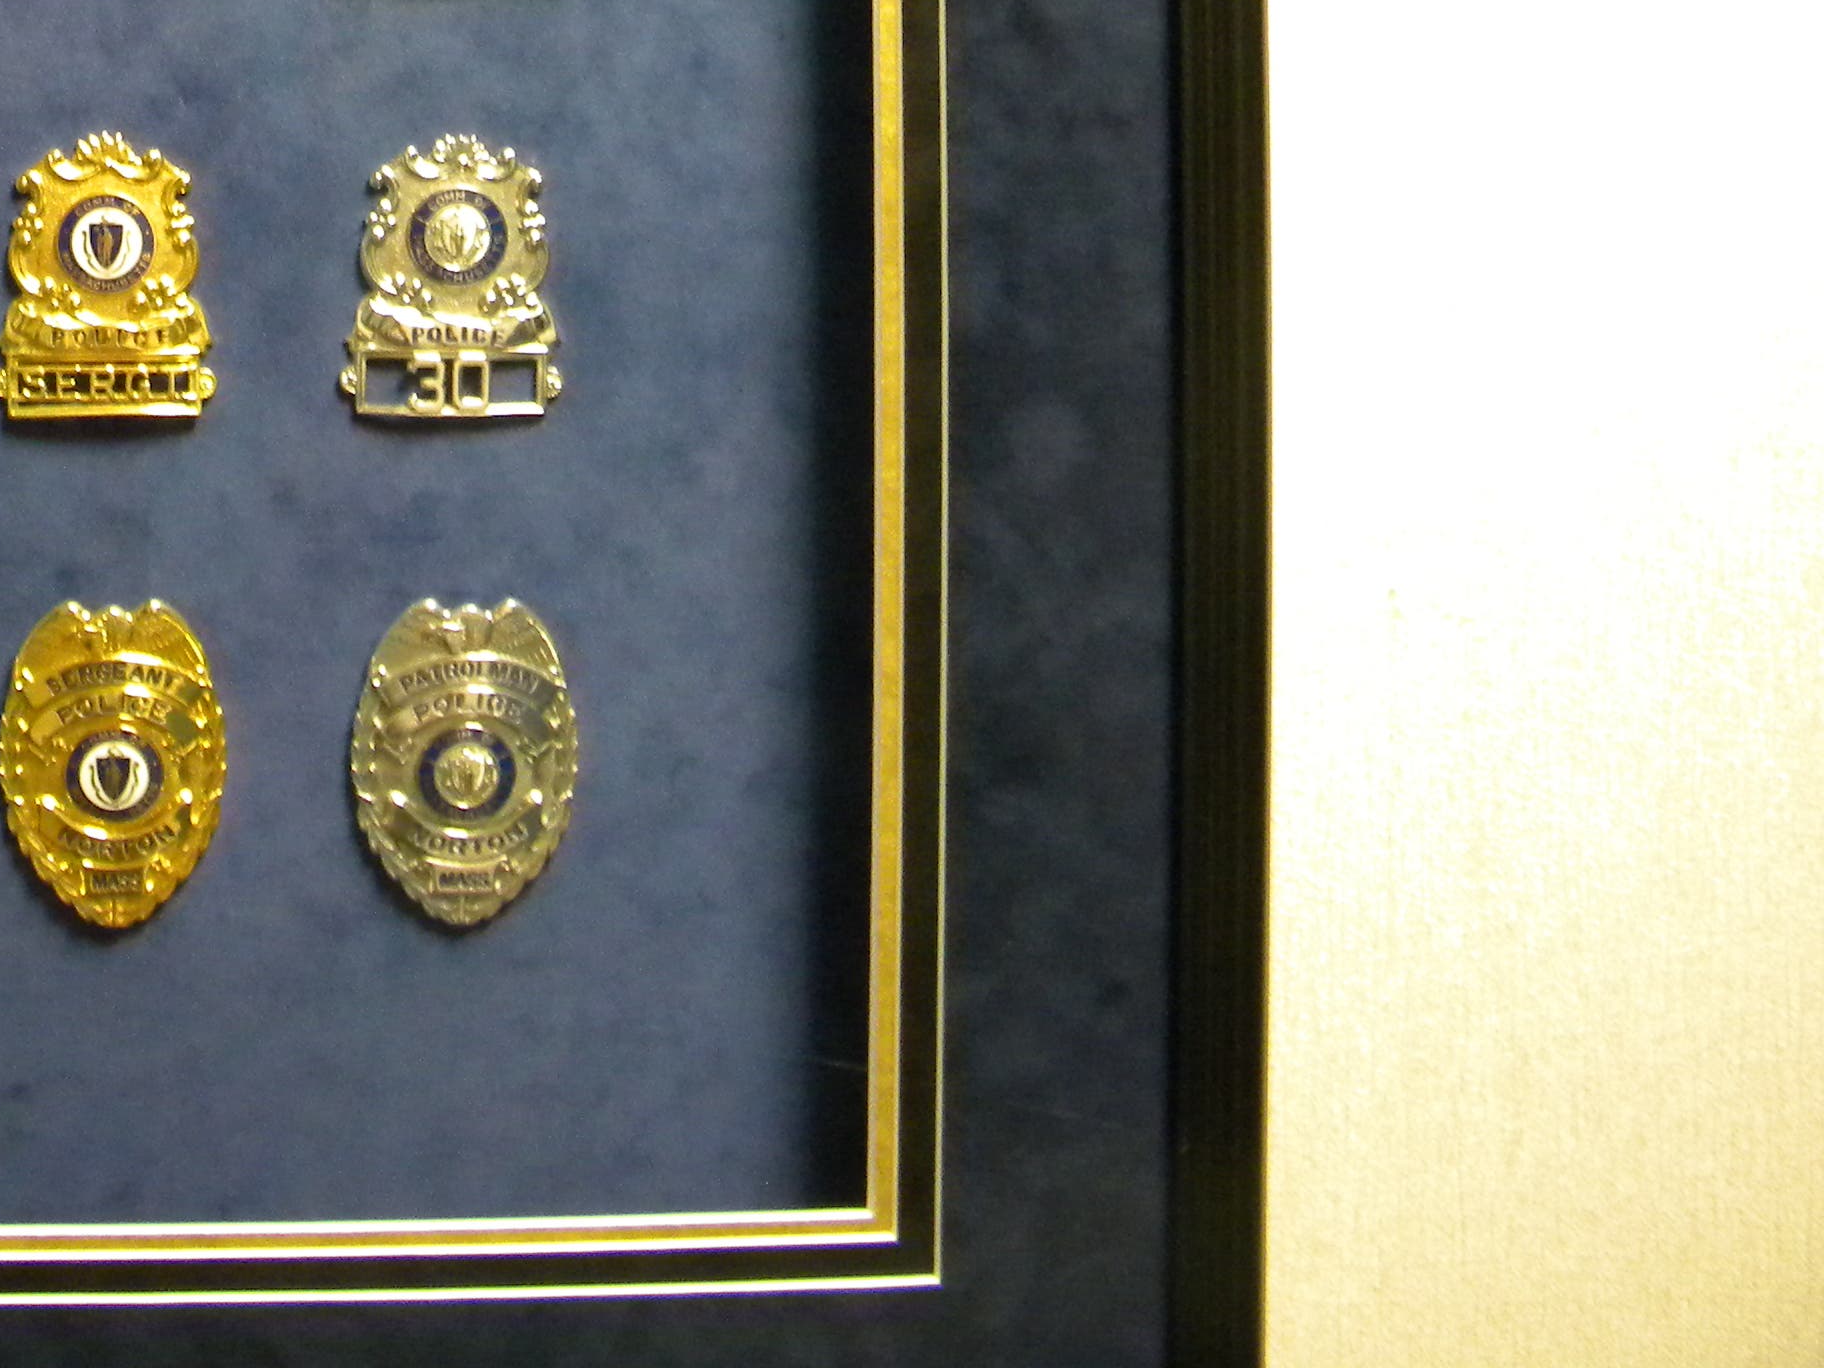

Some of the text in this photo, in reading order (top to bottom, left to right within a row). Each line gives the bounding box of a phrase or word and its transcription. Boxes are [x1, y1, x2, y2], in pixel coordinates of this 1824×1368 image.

[411, 326, 508, 346] POLICE
[406, 350, 490, 413] 30
[46, 664, 183, 698] SERGEANT
[56, 694, 172, 726] POLICE
[411, 693, 522, 726] POLICE
[58, 822, 180, 862] NORTON
